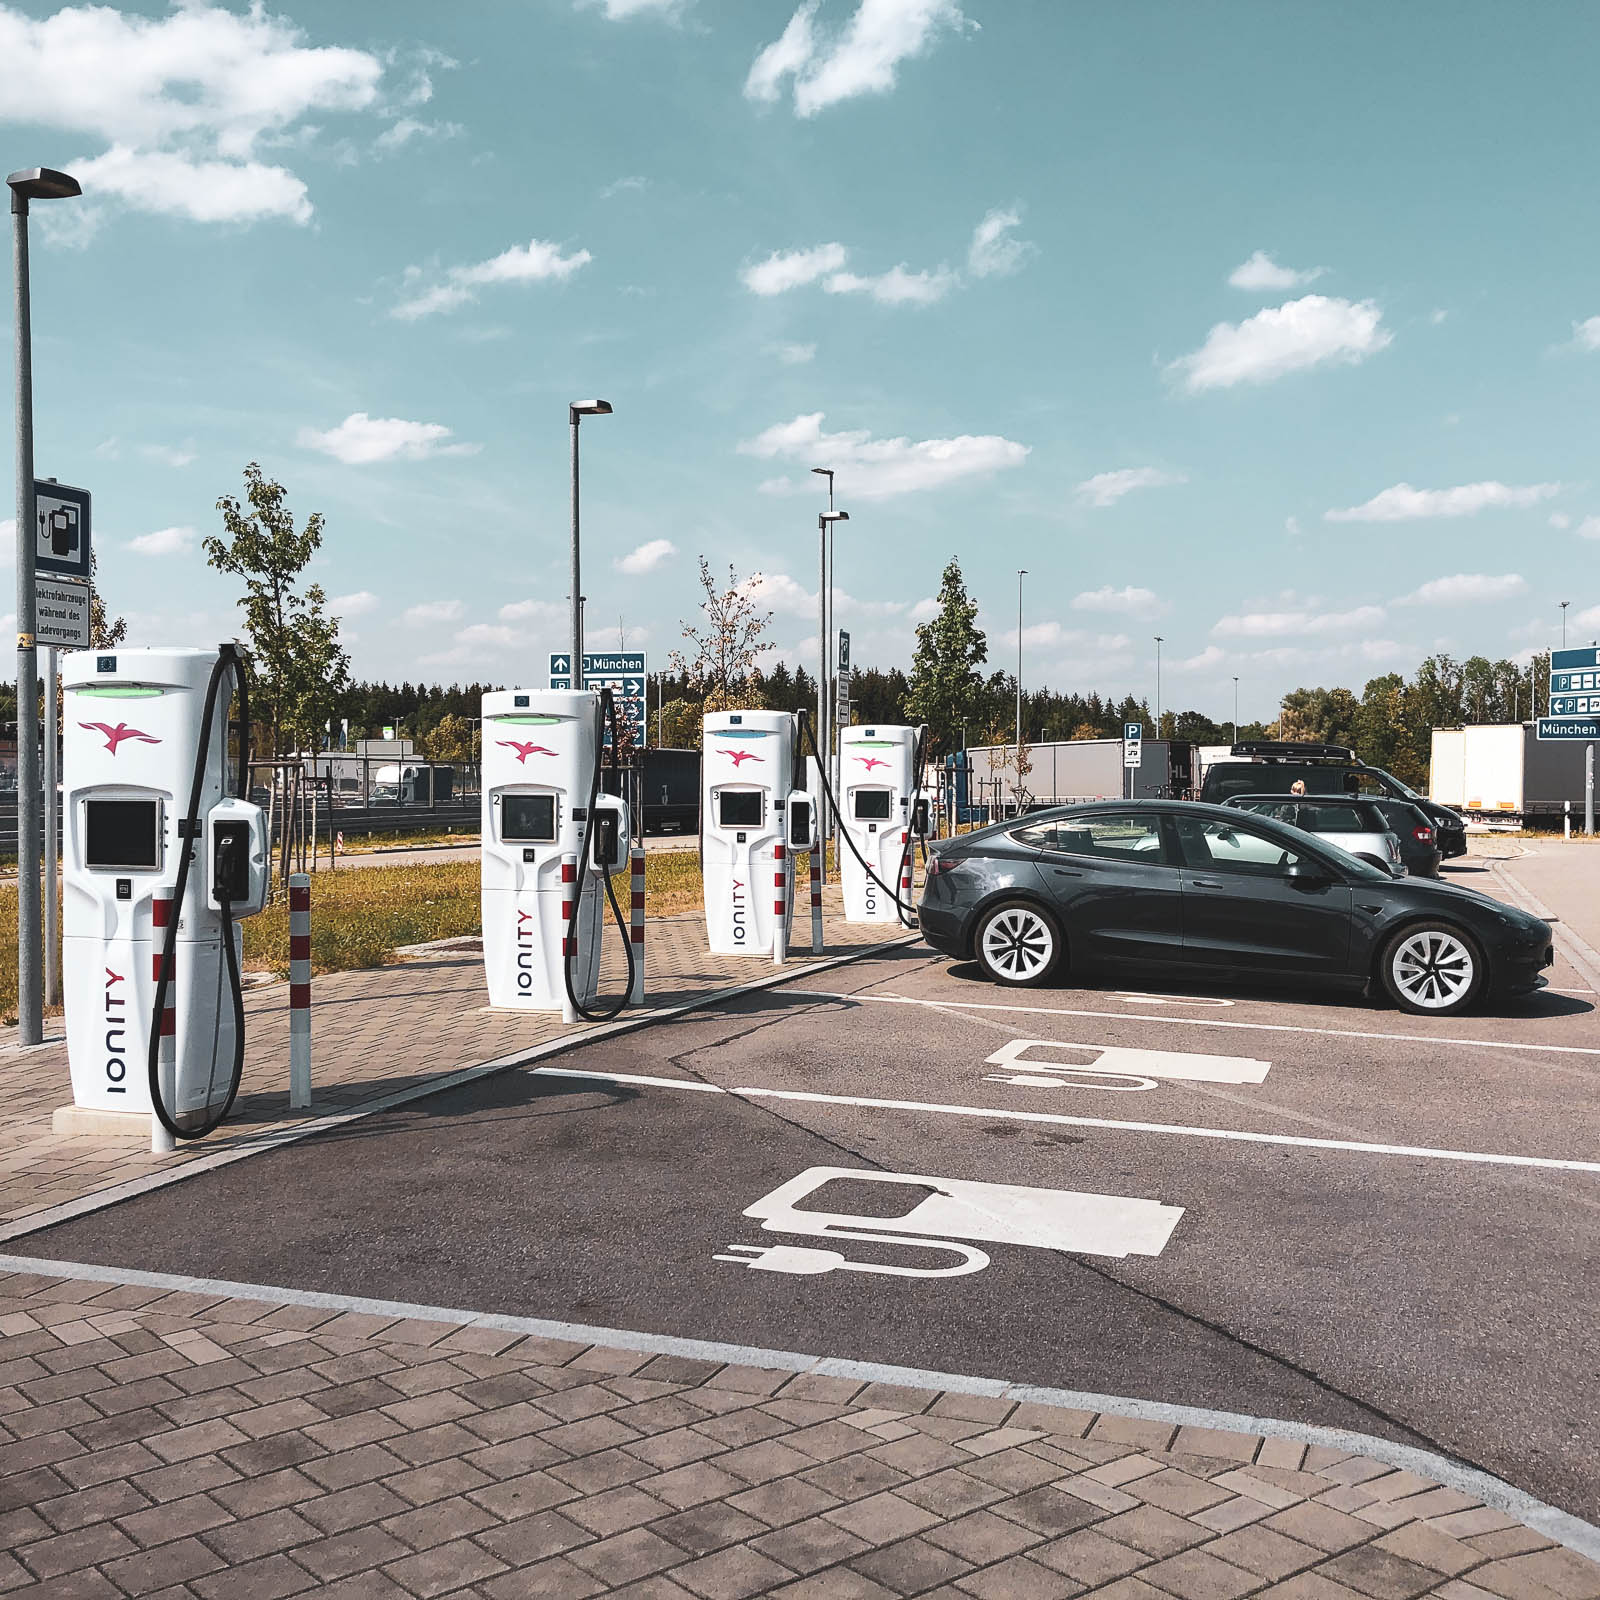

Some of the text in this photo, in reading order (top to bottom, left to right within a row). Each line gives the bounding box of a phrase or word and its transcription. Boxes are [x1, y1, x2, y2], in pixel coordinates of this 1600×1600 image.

[35, 587, 86, 606] lektrofahrzeuge
[38, 606, 80, 620] während des
[37, 623, 81, 640] Ladevorgangs
[593, 657, 642, 669] München
[1560, 677, 1567, 689] P
[1567, 701, 1574, 711] P
[1128, 726, 1138, 738] P
[1542, 723, 1597, 735] München
[493, 794, 500, 805] 2
[713, 791, 720, 800] 3
[732, 879, 746, 945] IONITY
[517, 909, 533, 997] IONITY
[105, 967, 126, 1093] IONITY
